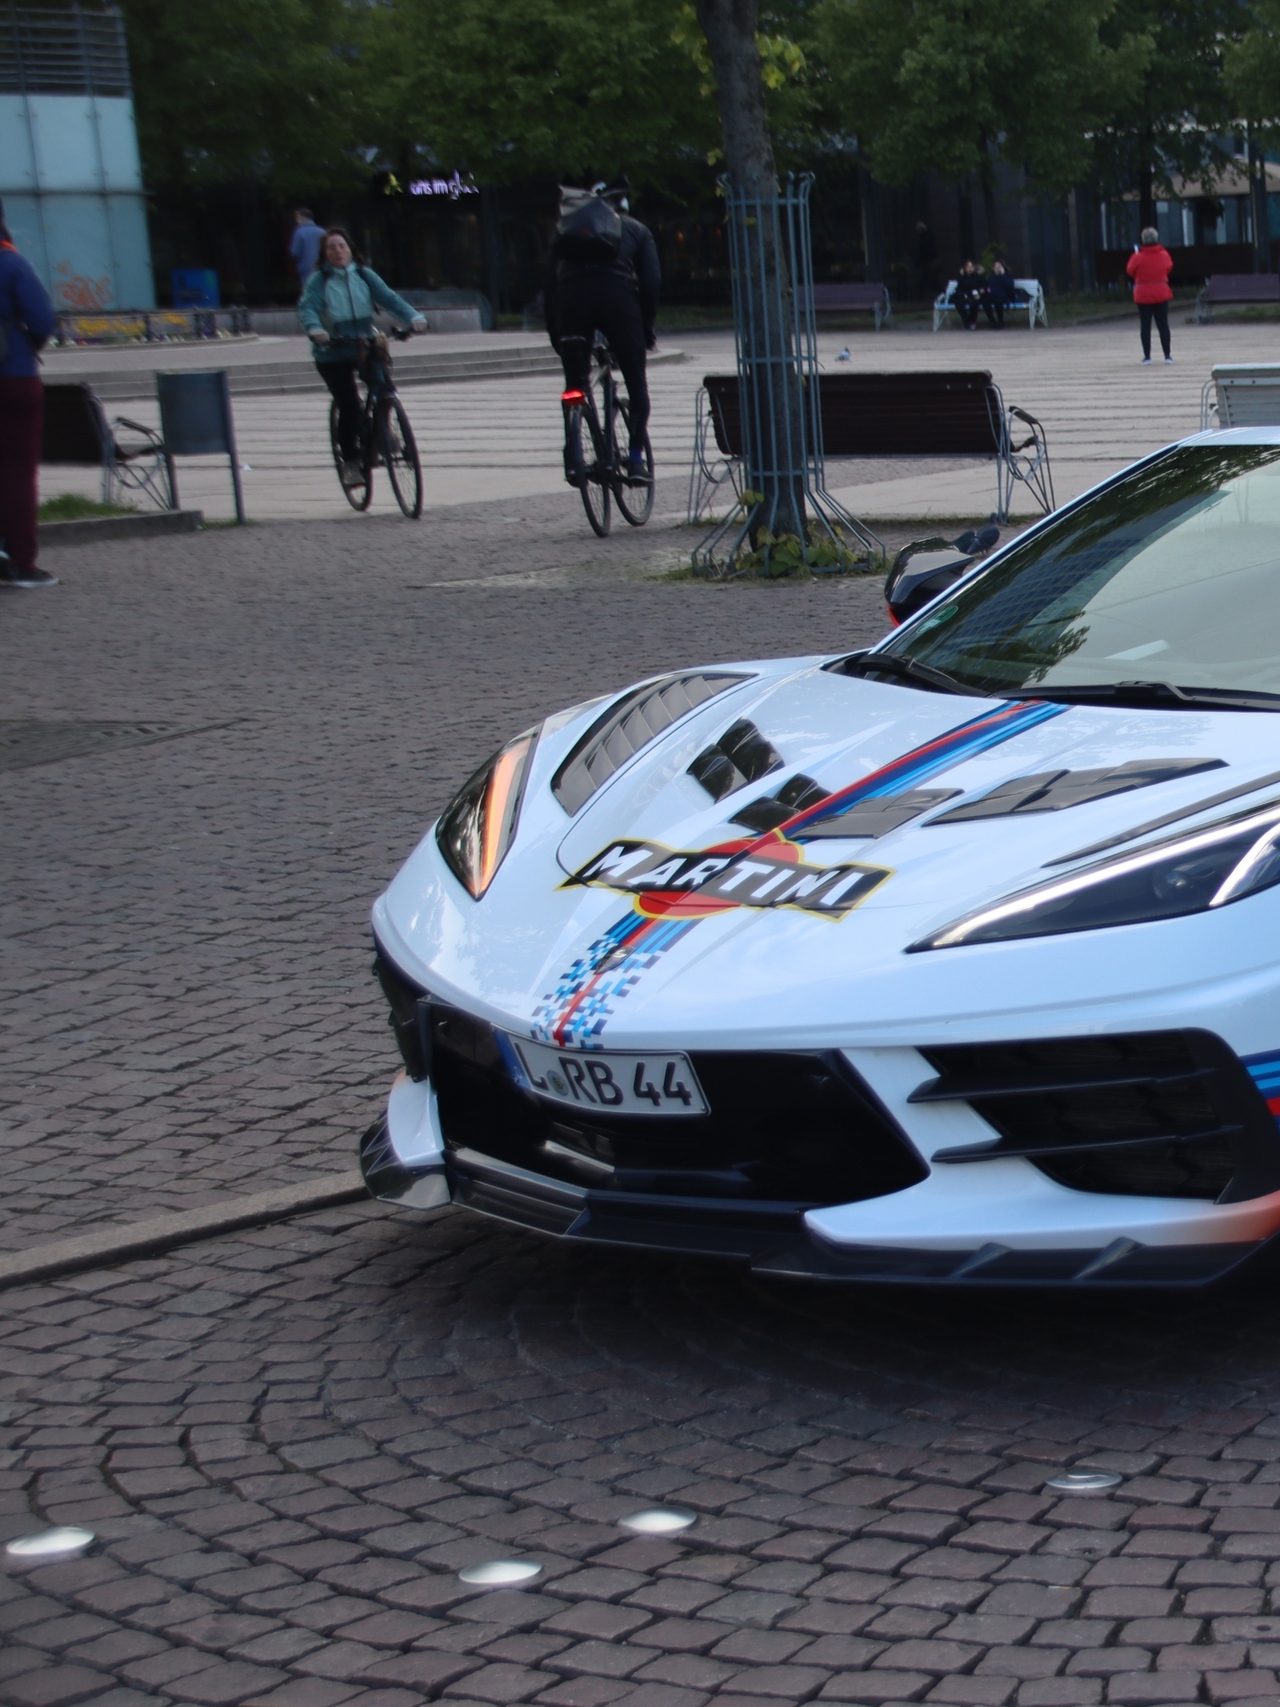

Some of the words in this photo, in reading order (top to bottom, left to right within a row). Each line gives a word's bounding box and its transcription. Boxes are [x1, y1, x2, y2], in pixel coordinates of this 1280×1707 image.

[582, 845, 866, 907] MARTINI
[513, 1042, 550, 1092] L
[558, 1056, 624, 1106] RB
[633, 1061, 693, 1107] 44
